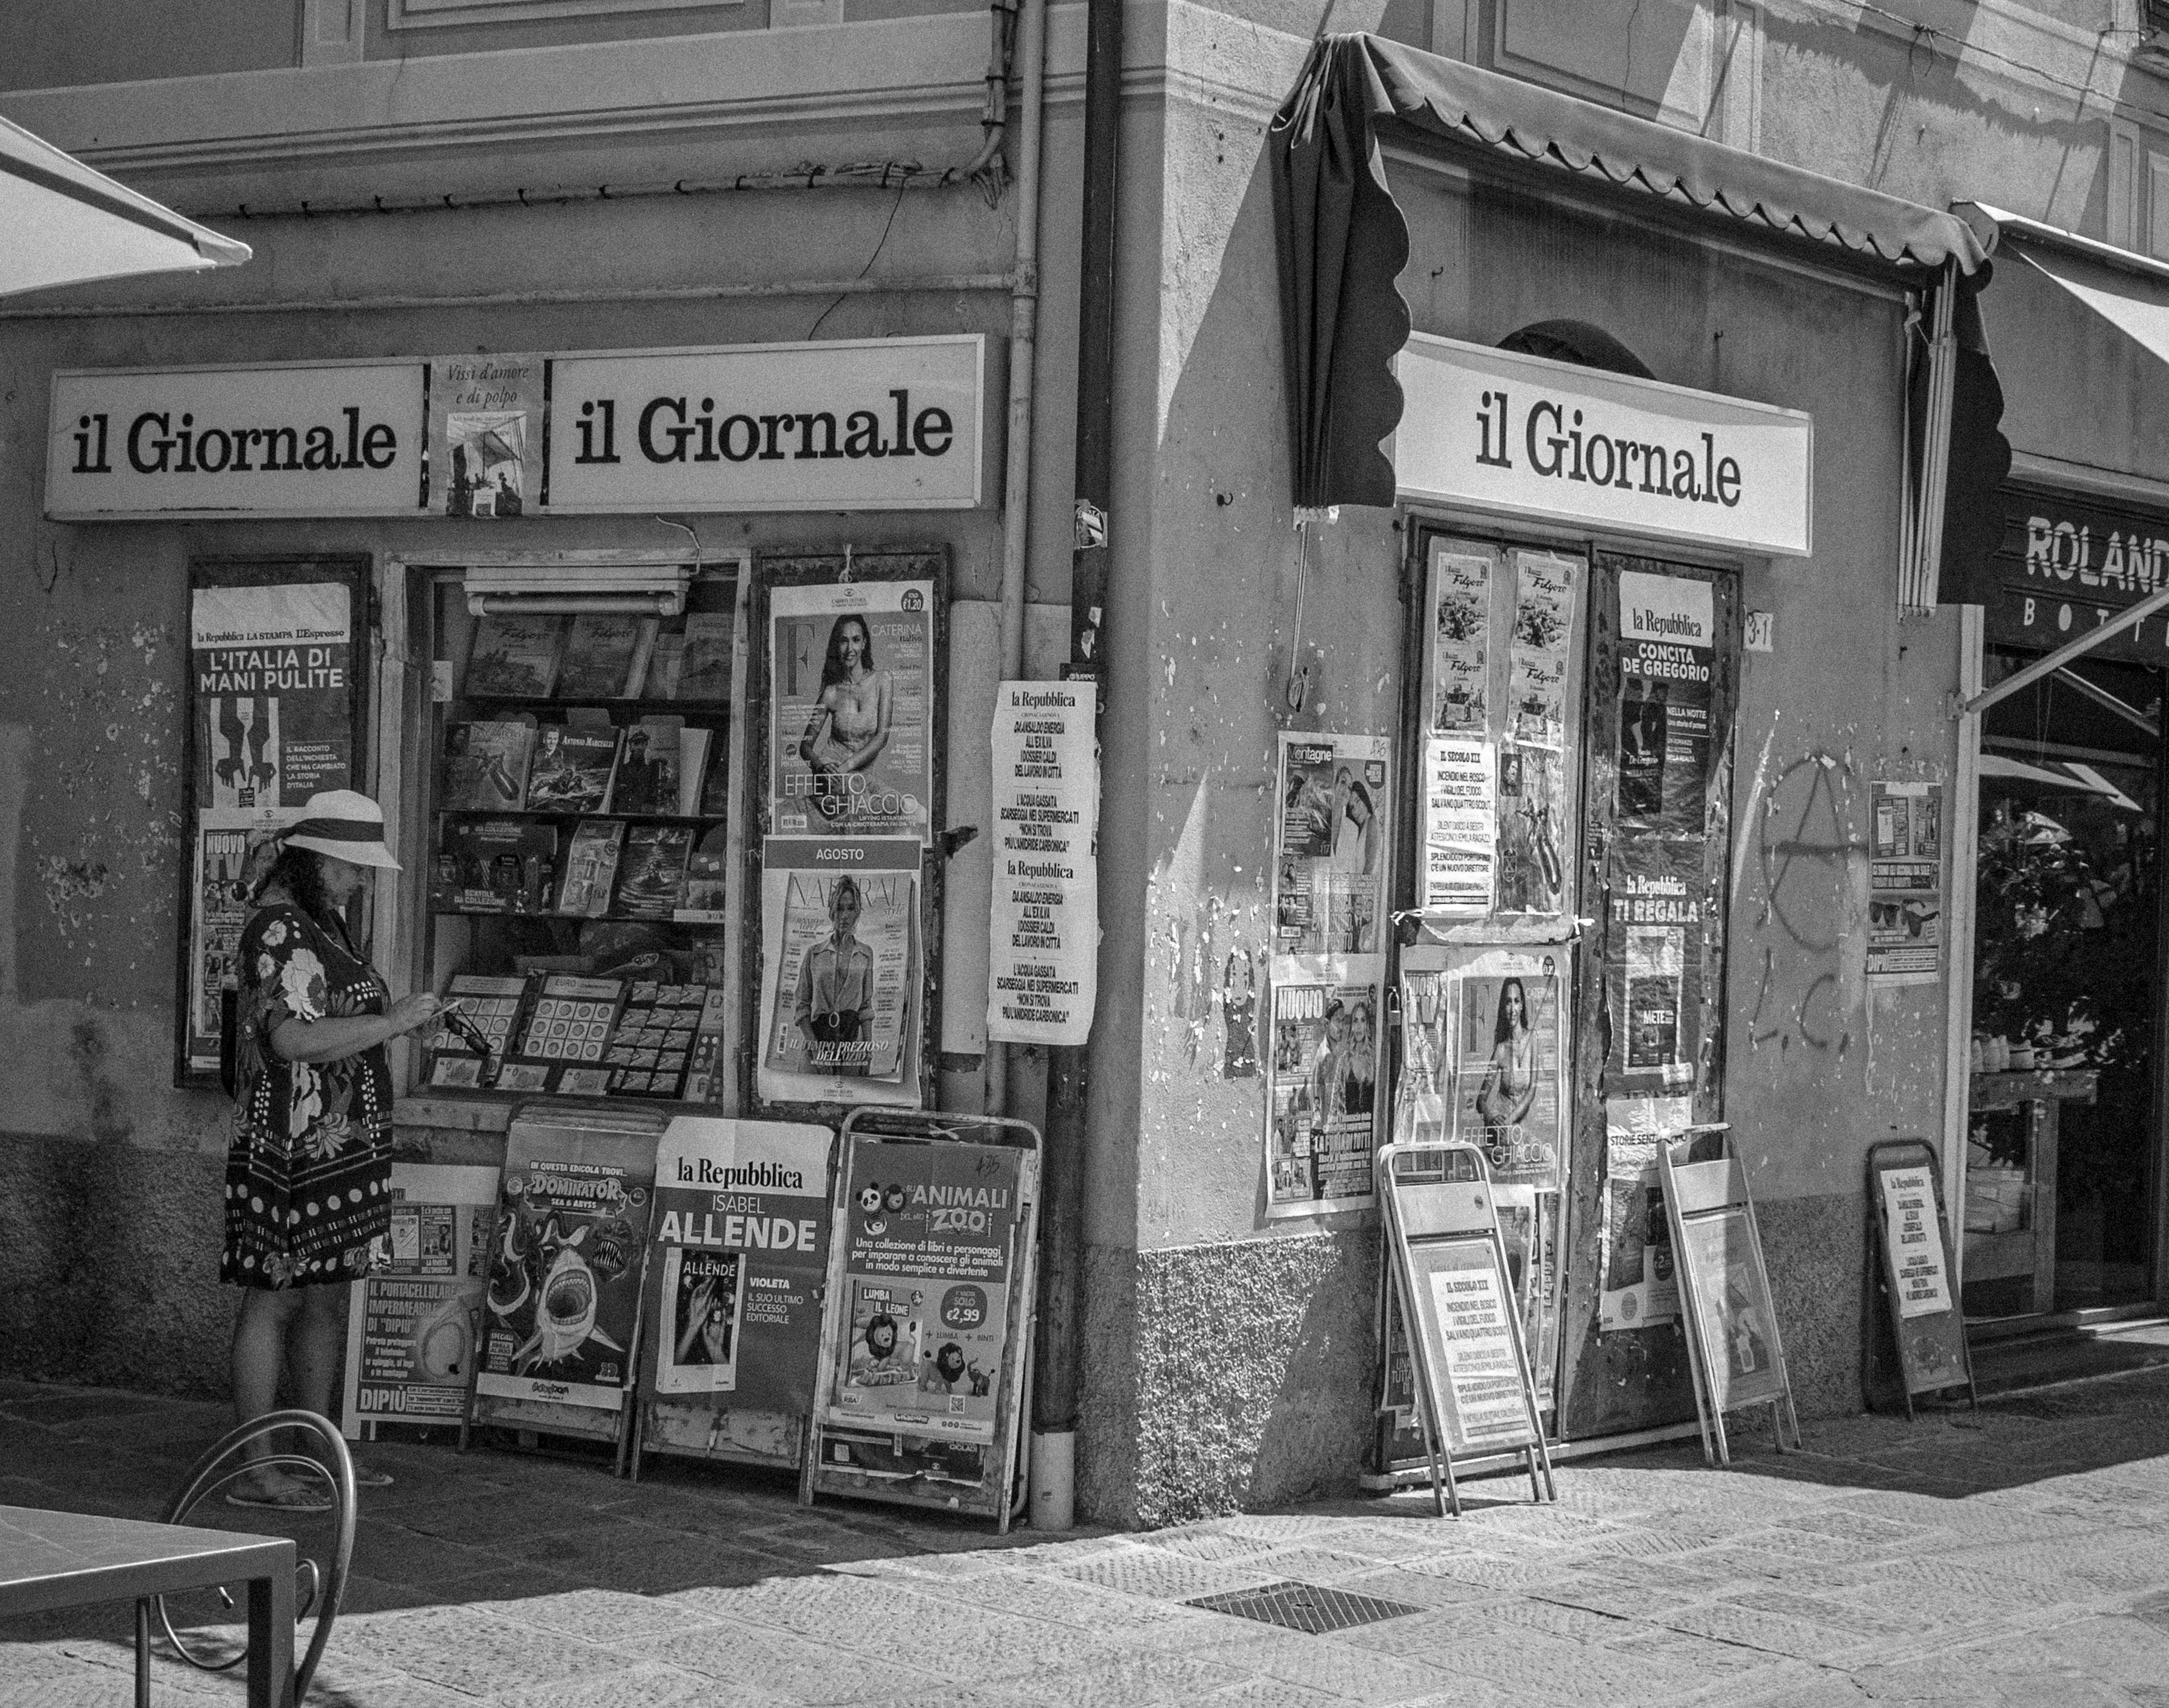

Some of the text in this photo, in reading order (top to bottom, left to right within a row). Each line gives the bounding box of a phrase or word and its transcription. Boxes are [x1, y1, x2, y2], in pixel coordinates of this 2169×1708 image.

[479, 363, 529, 380] d'amore
[467, 386, 517, 409] di polpo
[575, 389, 952, 464] il Giornale
[72, 407, 396, 473] il Giornale
[1476, 391, 1741, 507] il Giornale
[871, 624, 922, 636] CATERINA
[1633, 607, 1701, 637] la Repubblica
[198, 629, 345, 643] la Repubblica LA STAMPA L'Espresso
[210, 648, 331, 671] L'ITALIA DI
[1639, 643, 1695, 664] CONCITA
[1622, 657, 1709, 682] DE GREGORIO
[200, 668, 344, 692] MANI PULITE
[1012, 691, 1075, 709] la Repubblica
[1667, 706, 1707, 719] NELLA NOTTE
[1044, 722, 1065, 735] ENERGIA
[1022, 751, 1057, 764] DOSSIER CALDI
[1440, 751, 1481, 763] IL SECOLO XIX
[1015, 763, 1062, 778] DEL LAVORO CITTÀ
[1437, 771, 1486, 783] INCENDIO BOSCO
[786, 773, 866, 795] EFFETTO
[821, 794, 916, 815] GHIACCIO
[1017, 794, 1057, 808] L'ACQUA GASSATA
[1000, 807, 1079, 824] SCARSEGGIA SUPERMERCATI
[1037, 825, 1052, 838] TROVA
[207, 834, 246, 854] NUOVO
[816, 848, 864, 860] AGOSTO
[205, 853, 245, 880] TV
[1007, 860, 1074, 879] la Repubblica
[465, 889, 494, 898] SCATOLE
[1627, 874, 1686, 898] la Repubblica
[1042, 892, 1063, 906] ENERGIA
[1614, 899, 1698, 922] TI REGALA
[1020, 920, 1039, 933] DOSSIER
[1021, 933, 1060, 949] LAVORO CITTÀ
[1013, 963, 1056, 978] L'ACQUA GASSATA
[997, 976, 1078, 995] SCARSEGGIA SUPERMERCATI
[1035, 995, 1051, 1008] TROVA
[1278, 990, 1323, 1020] NUOVO
[836, 1038, 889, 1053] PREZIOSO
[816, 1050, 869, 1062] DELL'OZIO
[1463, 1125, 1523, 1145] EFFETTO
[1610, 1133, 1656, 1145] STORIE SENZ
[1491, 1143, 1553, 1164] GHIACCIO
[530, 1161, 600, 1174] IN QUESTA EDICOLA
[677, 1156, 803, 1190] la Repubblica
[533, 1172, 622, 1201] DOMINATOR
[1896, 1176, 1924, 1189] Repubblica
[551, 1198, 597, 1209] SEA ABYSS
[712, 1194, 766, 1215] ISABEL
[911, 1185, 1007, 1209] ANIMALI
[932, 1207, 986, 1232] ZOO
[658, 1211, 817, 1252] ALLENDE
[856, 1237, 873, 1248] Una
[875, 1238, 916, 1252] collezione
[918, 1239, 926, 1251] di
[928, 1240, 945, 1253] libri
[954, 1245, 1001, 1256] personaggi
[852, 1250, 866, 1261] per
[868, 1248, 906, 1263] imparare
[916, 1255, 957, 1264] conoscere
[959, 1254, 971, 1267] gli
[972, 1255, 1003, 1267] animali
[683, 1262, 735, 1277] ALLENDE
[865, 1259, 873, 1270] in
[875, 1260, 899, 1272] modo
[901, 1262, 937, 1276] semplice
[947, 1265, 988, 1277] divertente
[369, 1282, 456, 1300] IL PORTACELLULARE
[749, 1277, 790, 1289] VIOLETA
[1453, 1280, 1489, 1292] SECOLO XIX
[747, 1292, 803, 1305] IL SUO ULTIMO
[864, 1289, 890, 1300] LUMBA
[954, 1298, 976, 1306] SOLO
[368, 1300, 438, 1318] IMPERMEABILE
[747, 1303, 787, 1313] SUCCESSO
[875, 1303, 909, 1315] IL LEONE
[946, 1308, 980, 1324] €2,99
[367, 1318, 376, 1332] DI
[746, 1313, 789, 1324] EDITORIALE
[360, 1385, 406, 1412] DIPIÙ
